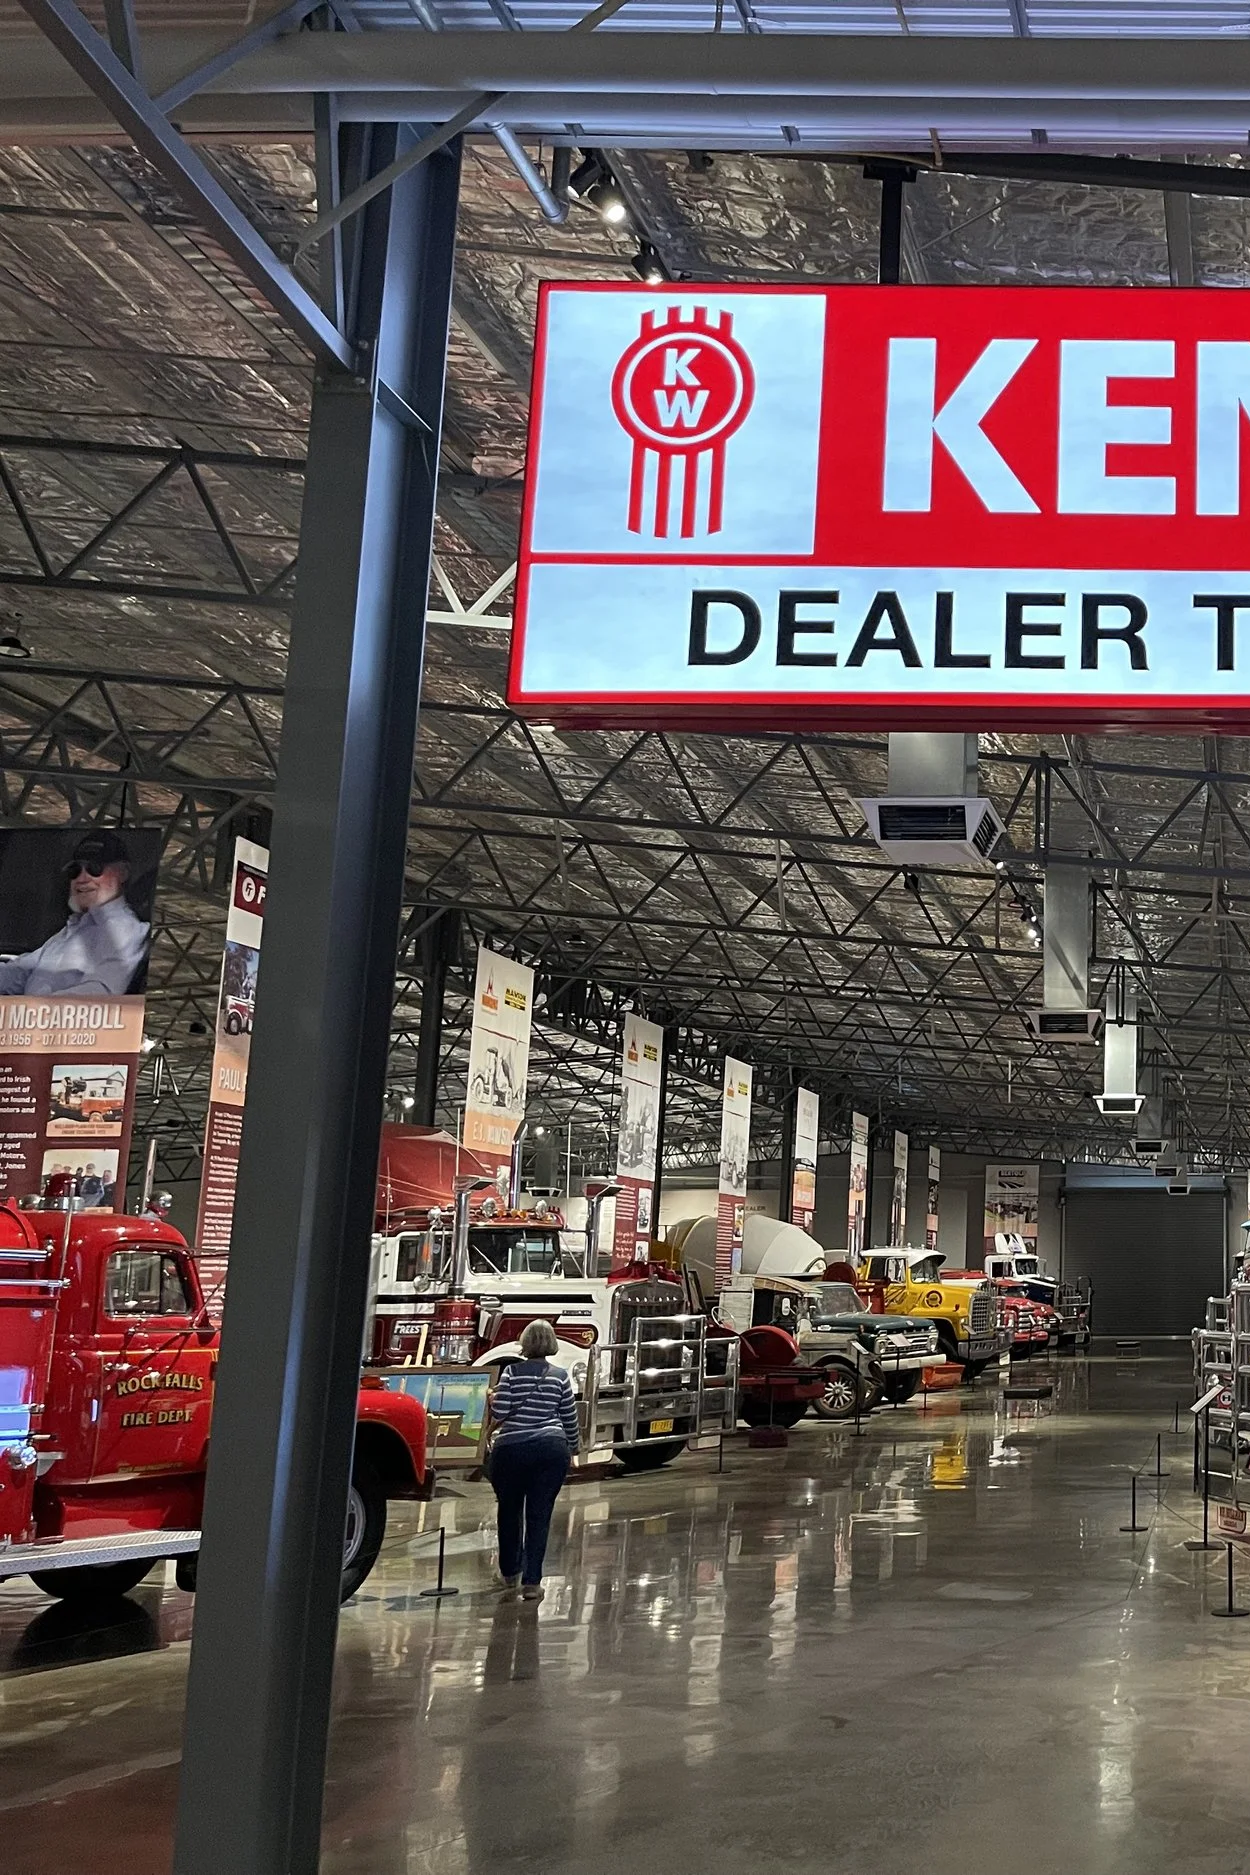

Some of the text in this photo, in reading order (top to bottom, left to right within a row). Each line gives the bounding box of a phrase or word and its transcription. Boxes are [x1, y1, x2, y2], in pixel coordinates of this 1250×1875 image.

[688, 590, 1149, 672] DEALER
[8, 1004, 125, 1030] McCARROLL
[42, 1033, 96, 1047] 07.11.2020
[163, 1373, 205, 1392] FALLS
[122, 1409, 194, 1427] FIRE DEPT.
